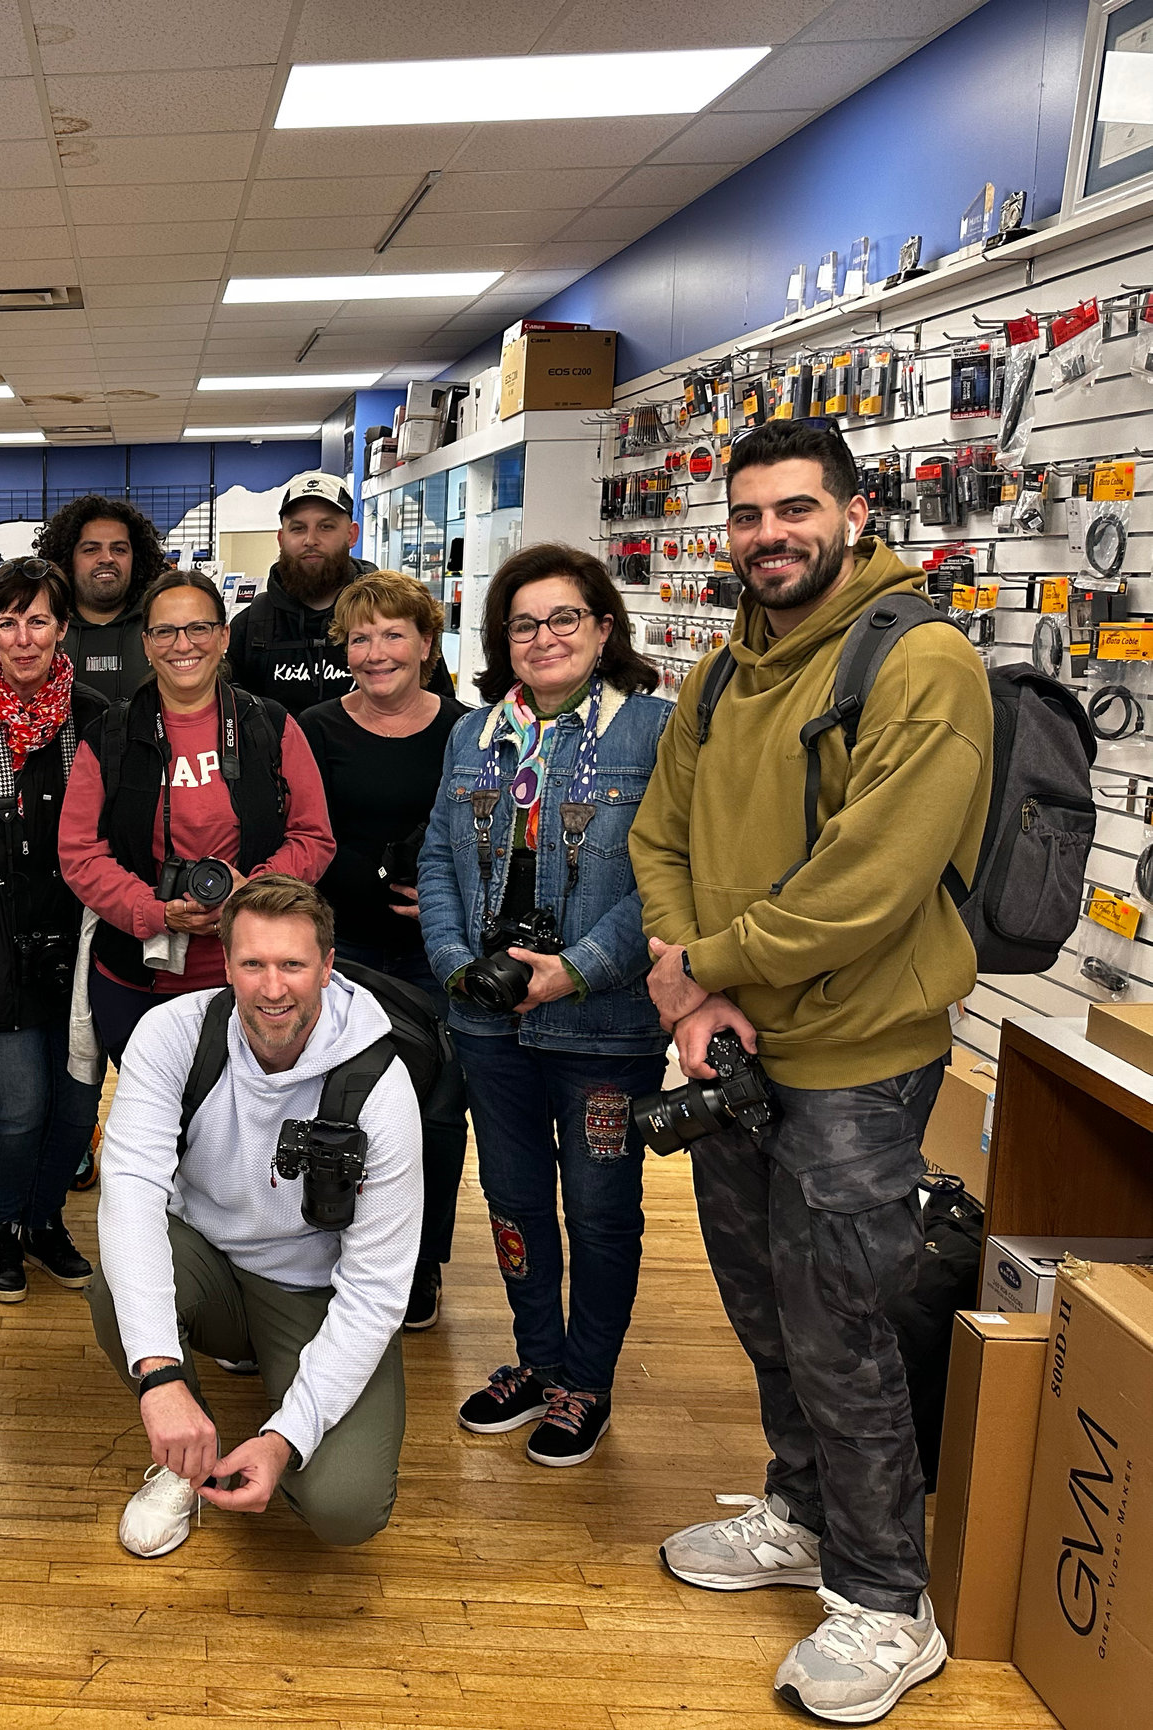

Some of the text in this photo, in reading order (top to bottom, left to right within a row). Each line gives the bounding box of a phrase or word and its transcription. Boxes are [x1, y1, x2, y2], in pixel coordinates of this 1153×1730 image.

[548, 368, 570, 376] EOS
[1122, 637, 1139, 645] Cable
[274, 663, 311, 681] Keith
[156, 713, 165, 739] Canon
[226, 718, 235, 748] EOS R6
[161, 750, 220, 788] AP
[1050, 1296, 1072, 1399] 800D-II
[1056, 1406, 1119, 1637] GVM
[1099, 1459, 1134, 1660] GREAT VIDEO MAKER
